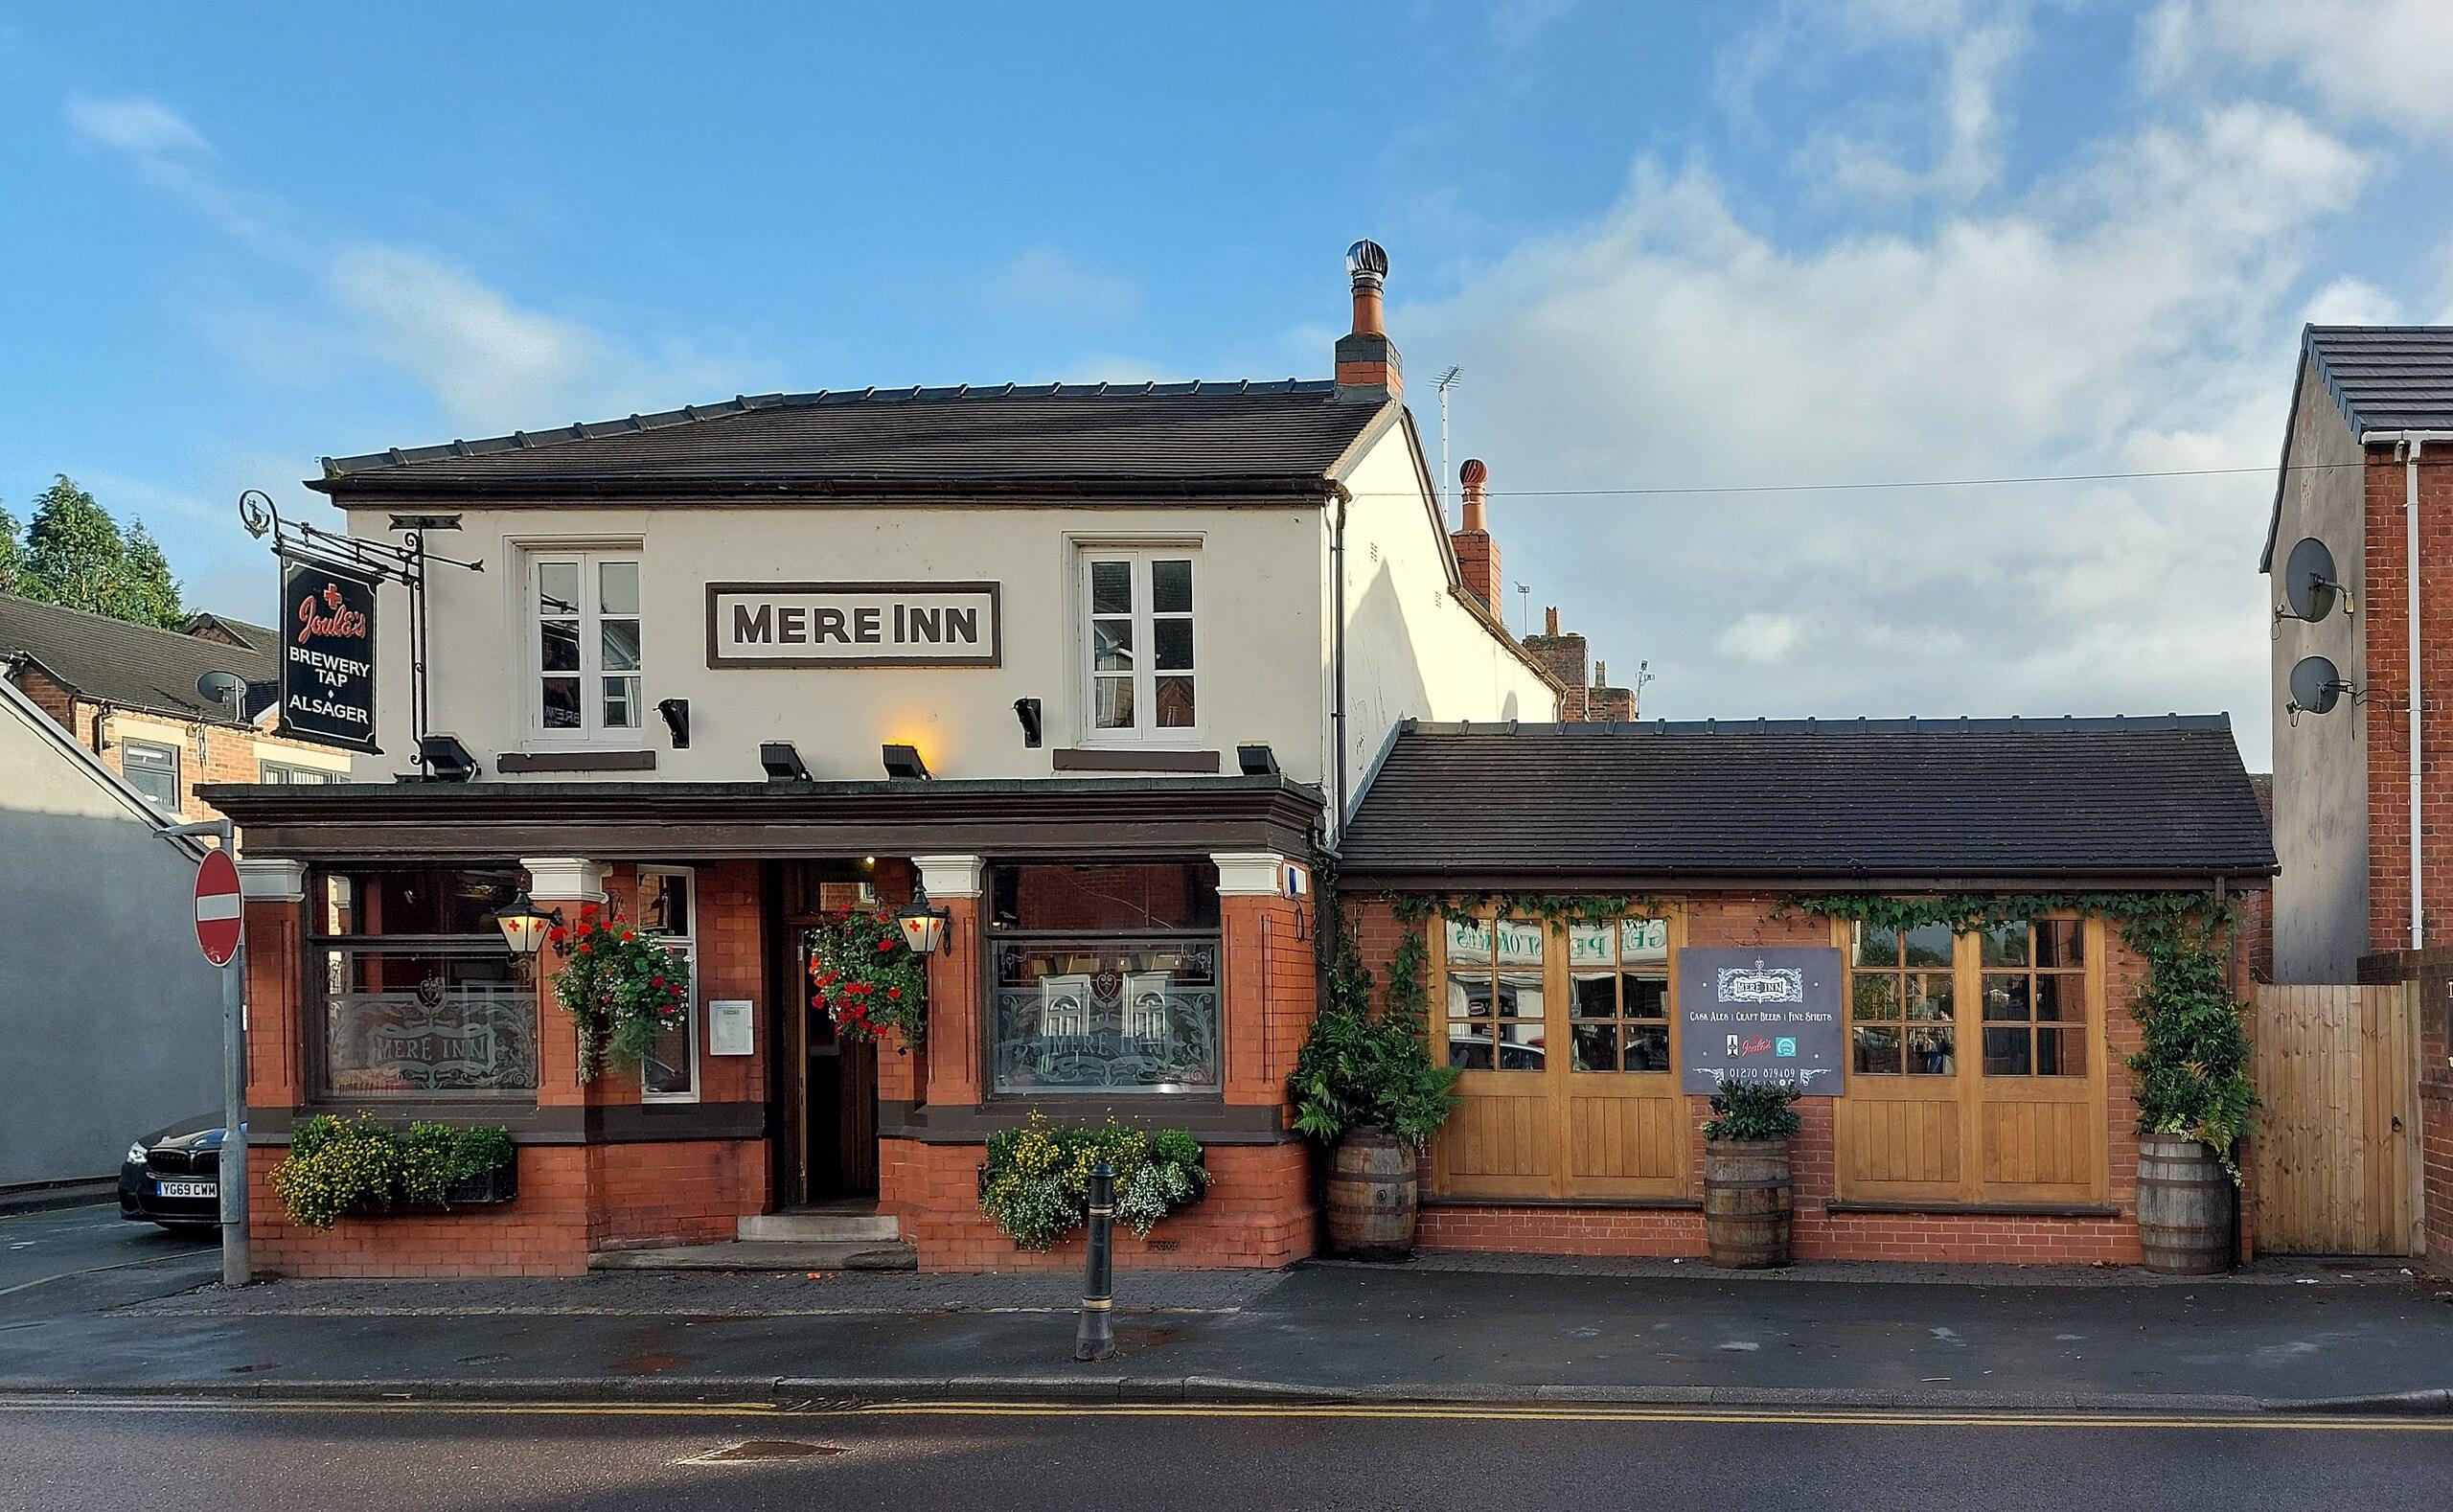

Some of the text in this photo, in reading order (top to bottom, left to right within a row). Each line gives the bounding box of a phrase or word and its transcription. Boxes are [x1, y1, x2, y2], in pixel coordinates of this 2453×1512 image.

[733, 604, 977, 644] MERE INN
[289, 646, 371, 677] BREWERY
[314, 669, 349, 687] TAP
[288, 694, 369, 724] ALSAGER
[1737, 981, 1784, 994] MERE INN
[377, 1033, 486, 1061] MERE INN
[1050, 1033, 1108, 1055] MERE
[1730, 1067, 1758, 1079] 01270
[163, 1183, 216, 1196] YG69 CWM
